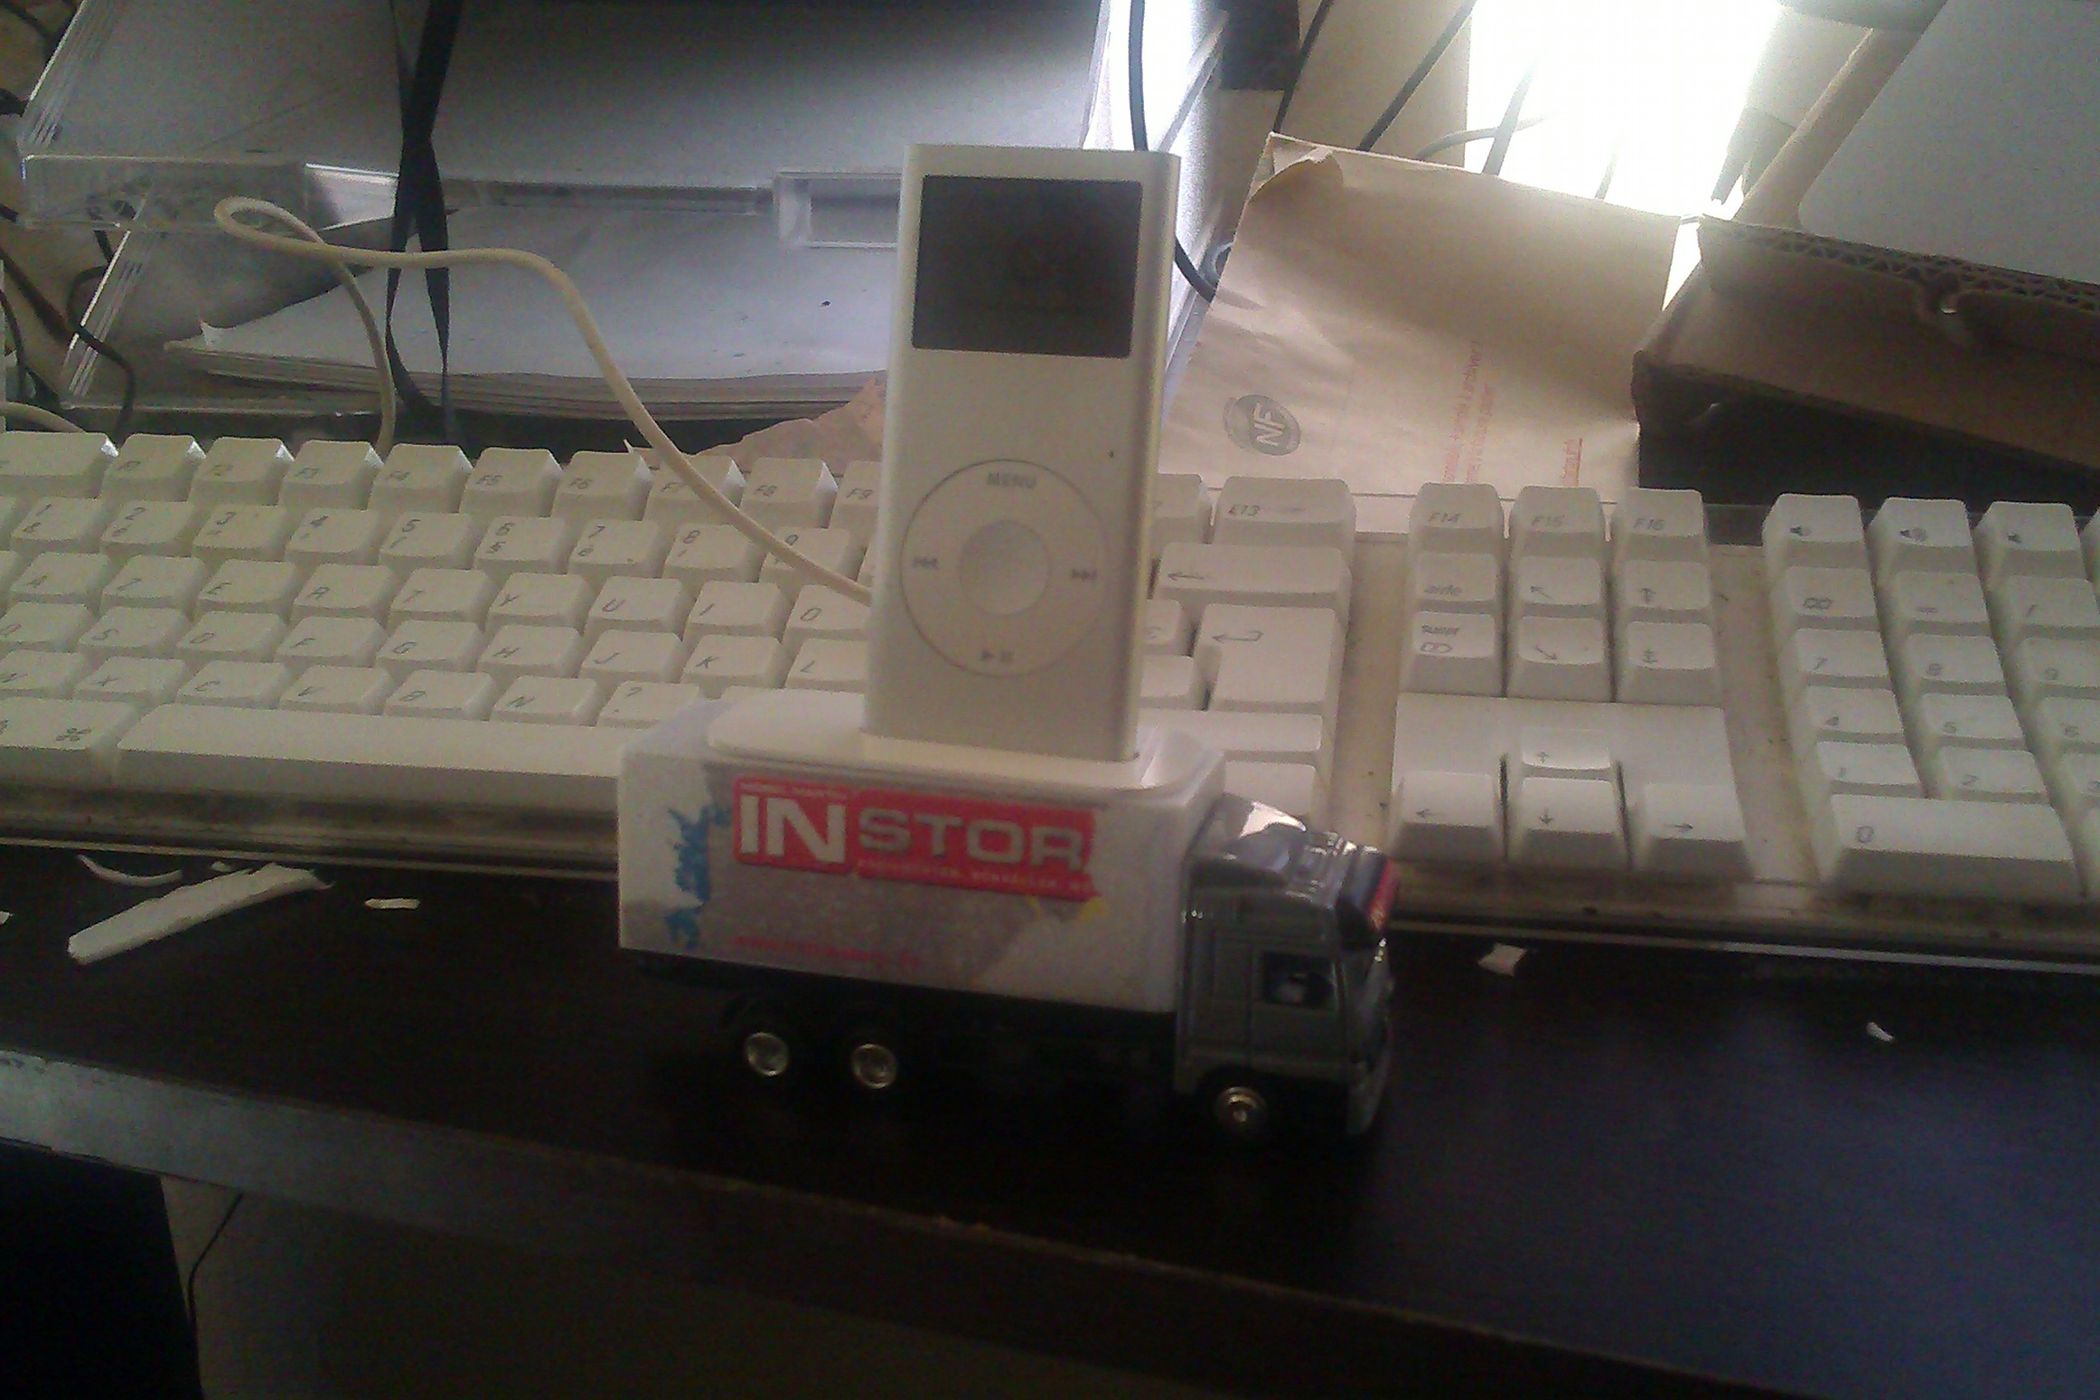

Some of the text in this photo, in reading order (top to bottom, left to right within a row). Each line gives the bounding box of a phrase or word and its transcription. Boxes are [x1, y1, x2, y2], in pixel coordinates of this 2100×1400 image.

[1254, 402, 1286, 447] NF
[475, 474, 503, 486] F5
[569, 477, 593, 490] F6
[125, 506, 147, 522] 2
[216, 511, 237, 526] 3
[1427, 511, 1461, 524] F14
[402, 518, 422, 534] 5
[496, 521, 516, 537] 6
[588, 525, 606, 540] 7
[682, 529, 701, 545] 8
[306, 586, 331, 600] R
[403, 590, 426, 604] T
[498, 594, 521, 608] Y
[602, 599, 626, 613] U
